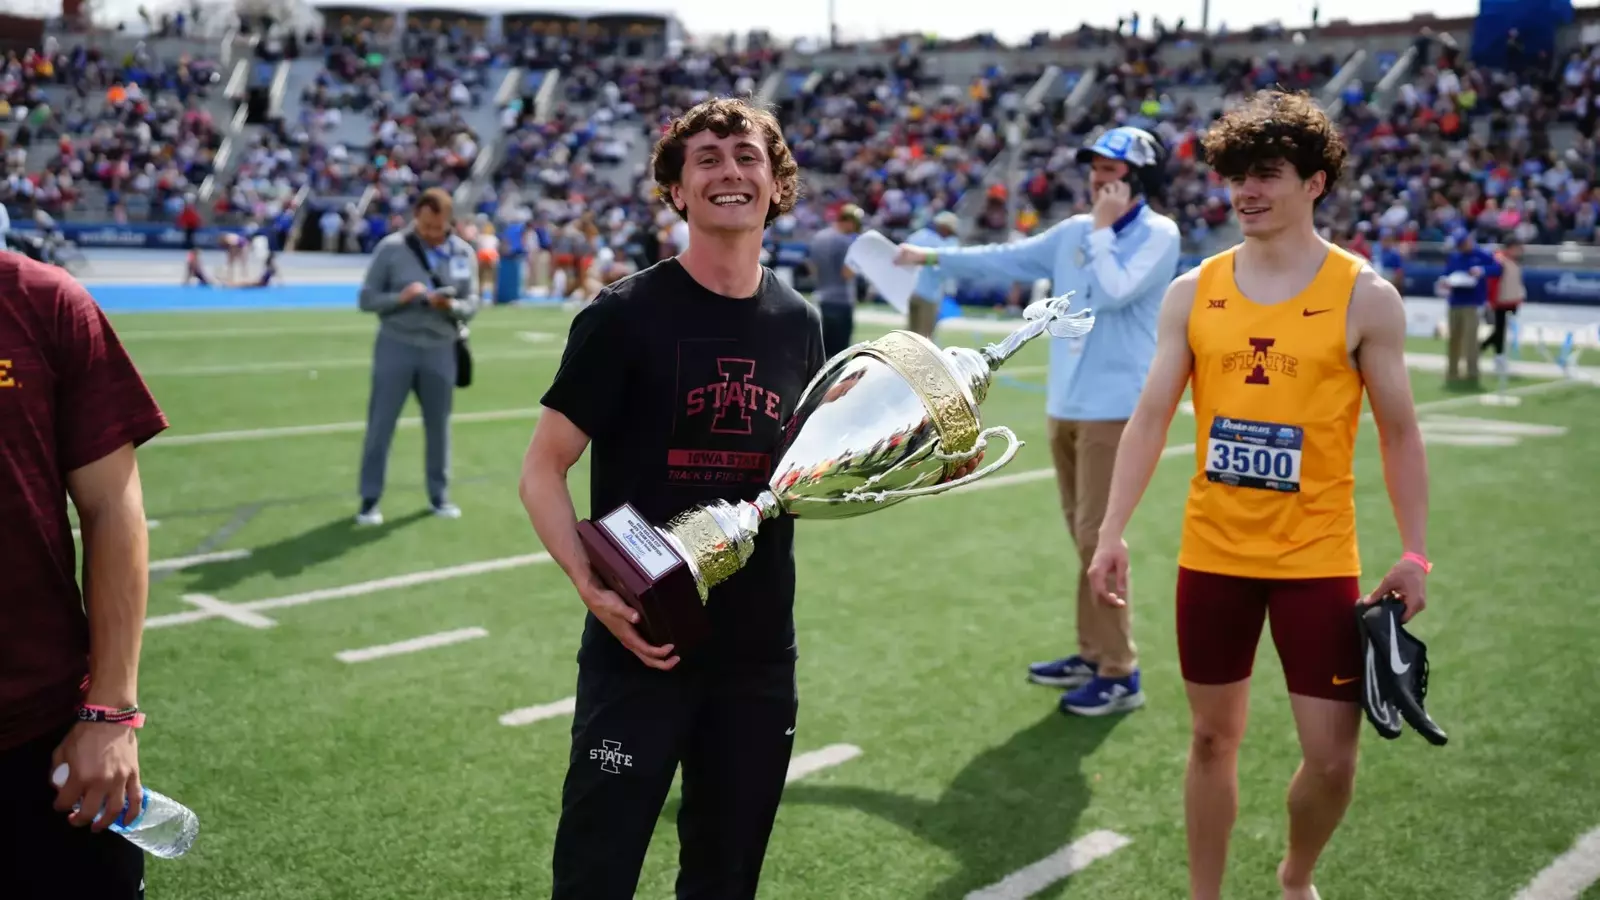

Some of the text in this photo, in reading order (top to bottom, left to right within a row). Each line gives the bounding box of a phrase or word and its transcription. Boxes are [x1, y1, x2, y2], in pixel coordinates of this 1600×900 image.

[1222, 350, 1298, 378] STATE
[687, 381, 780, 420] STATE
[688, 452, 724, 465] IOWA
[1212, 443, 1293, 478] 3500
[667, 469, 700, 480] TRACK
[590, 749, 633, 767] STATE
